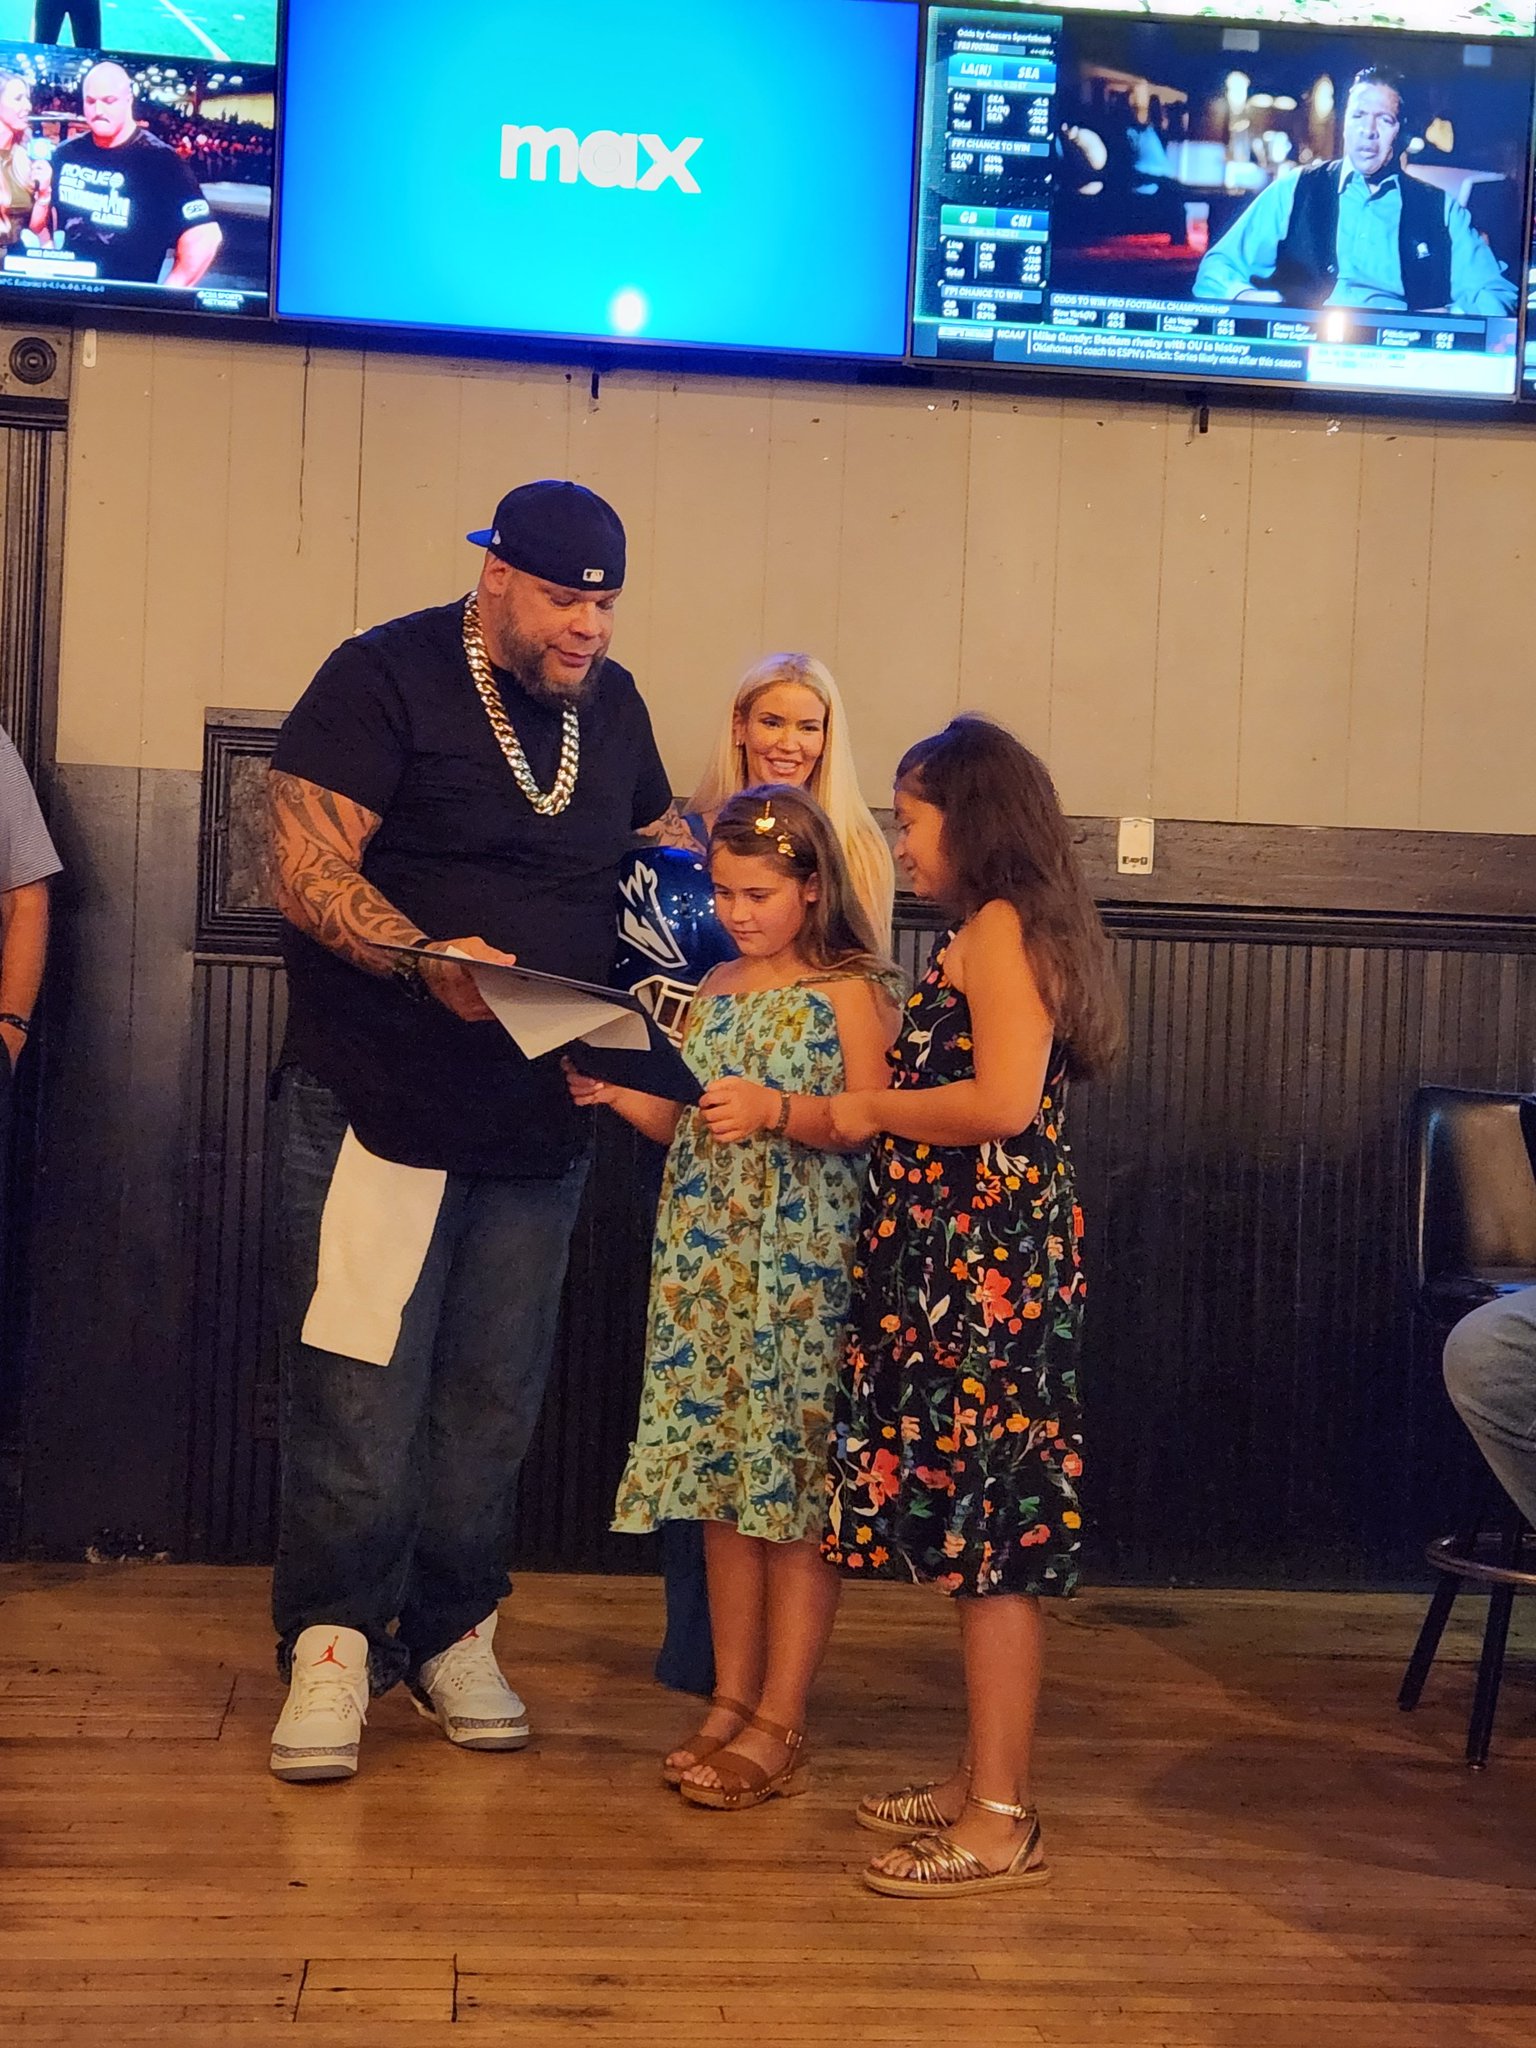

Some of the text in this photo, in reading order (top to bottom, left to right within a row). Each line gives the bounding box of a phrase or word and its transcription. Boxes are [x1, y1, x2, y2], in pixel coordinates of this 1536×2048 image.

[957, 28, 975, 38] Odds
[976, 30, 985, 40] by
[1012, 32, 1051, 45] Sportsbook
[960, 62, 992, 77] LA(N)
[1017, 66, 1040, 80] SEA
[987, 93, 1004, 105] SEA
[953, 118, 972, 131] Total
[986, 113, 1004, 124] SEA
[966, 138, 1000, 151] CHANCE
[1001, 142, 1013, 151] TO
[1013, 143, 1031, 153] WIN
[500, 124, 704, 194] max
[950, 161, 967, 172] SEA
[959, 210, 978, 224] GB
[1010, 214, 1032, 228] CHI
[945, 267, 965, 279] Total
[959, 287, 993, 299] CHANCE
[994, 290, 1006, 299] TO
[1006, 291, 1023, 301] WIN
[1053, 295, 1230, 314] ODDS TO WIN PRO FOOTBALL CHAMPIONSHIP
[1177, 317, 1199, 328] Vegas
[997, 329, 1027, 341] NCAAF
[1033, 330, 1250, 355] Mike Gundy: Bedlam rivalry with OU is history
[1033, 343, 1073, 354] Oklahoma
[1073, 345, 1082, 355] St
[1083, 346, 1106, 356] coach
[1107, 347, 1116, 357] to
[1117, 348, 1145, 360] ESPN's
[1173, 352, 1198, 363] Series
[1219, 355, 1239, 364] ends
[1239, 356, 1258, 366] after
[1258, 357, 1274, 367] this
[1274, 359, 1303, 370] season
